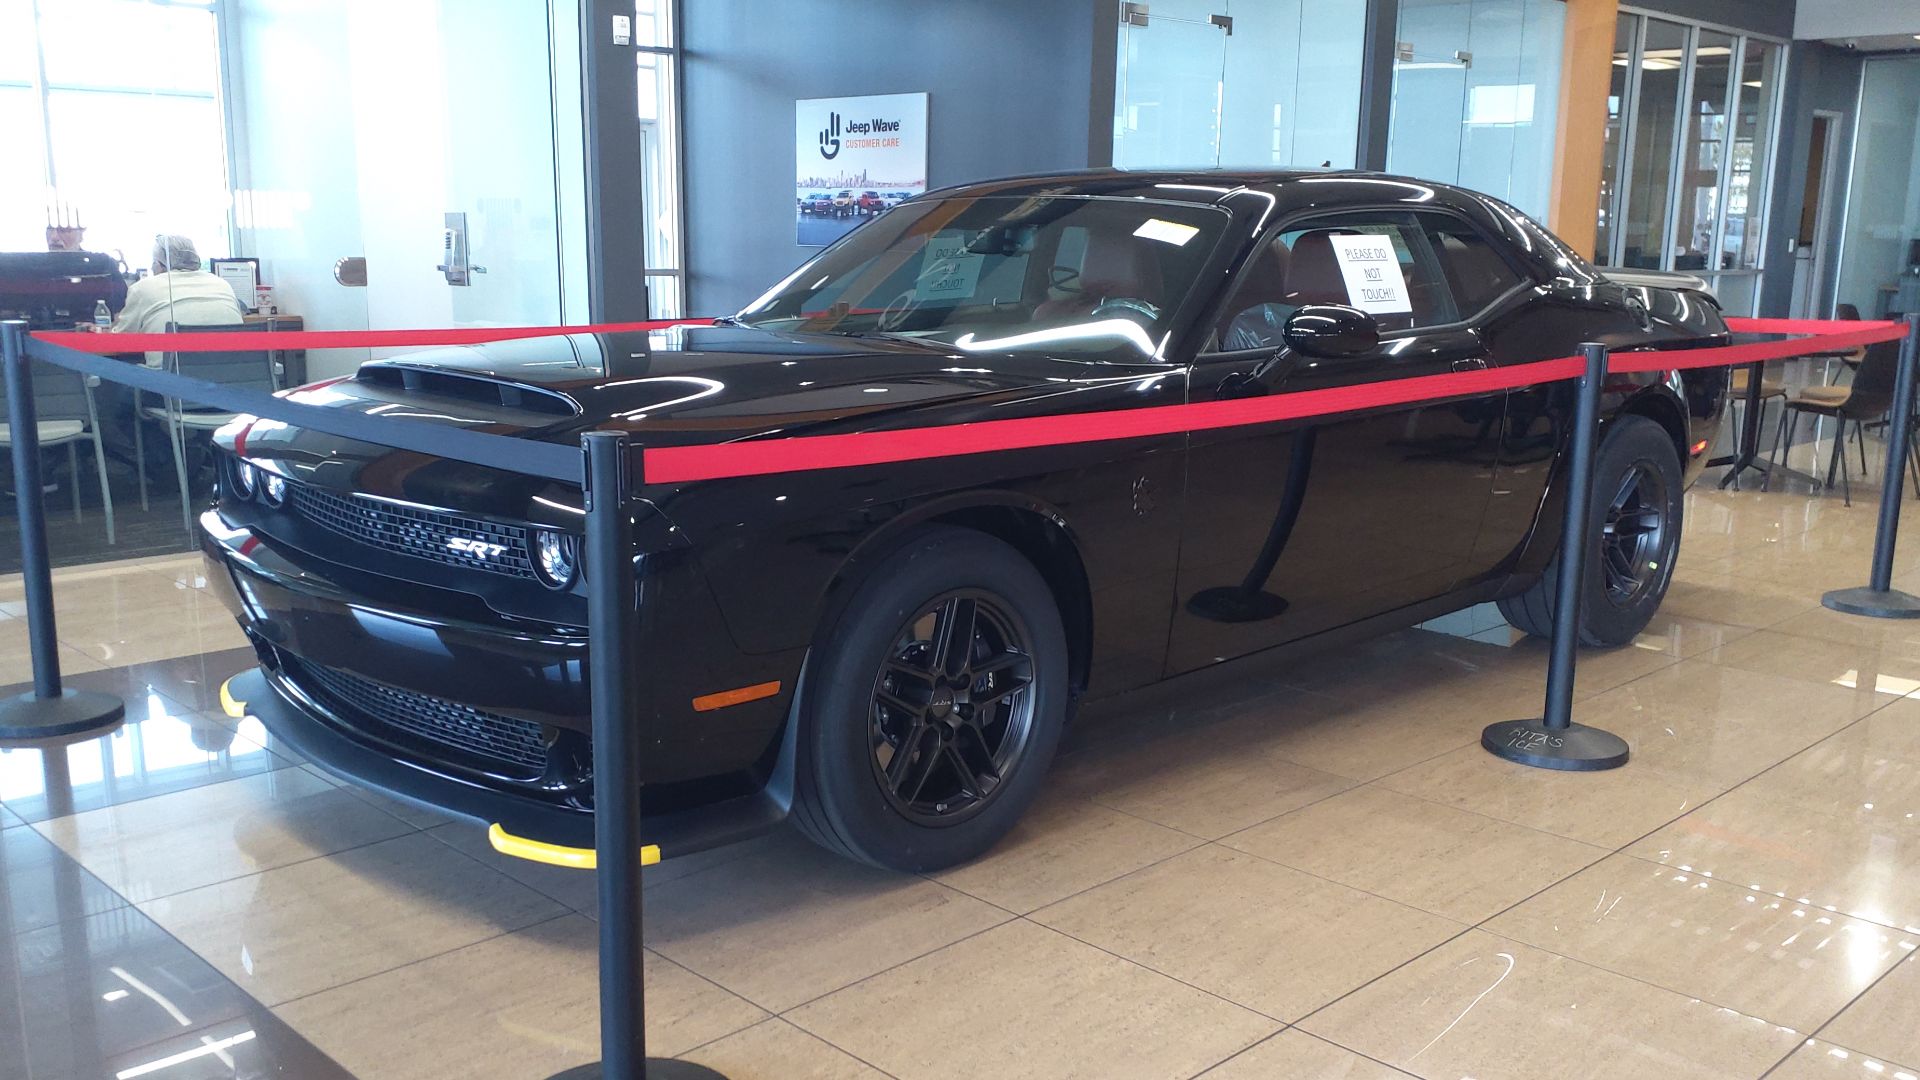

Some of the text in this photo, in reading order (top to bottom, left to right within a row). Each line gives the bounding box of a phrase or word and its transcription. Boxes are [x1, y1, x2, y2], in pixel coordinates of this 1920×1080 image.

[846, 120, 870, 135] Jeep
[846, 138, 900, 149] CUSTOMER CARE
[1344, 248, 1387, 260] PLEASE DO
[1364, 268, 1382, 279] NOT
[1361, 287, 1396, 300] TOUCH!!
[446, 537, 508, 560] SRT
[1507, 738, 1539, 751] ICE
